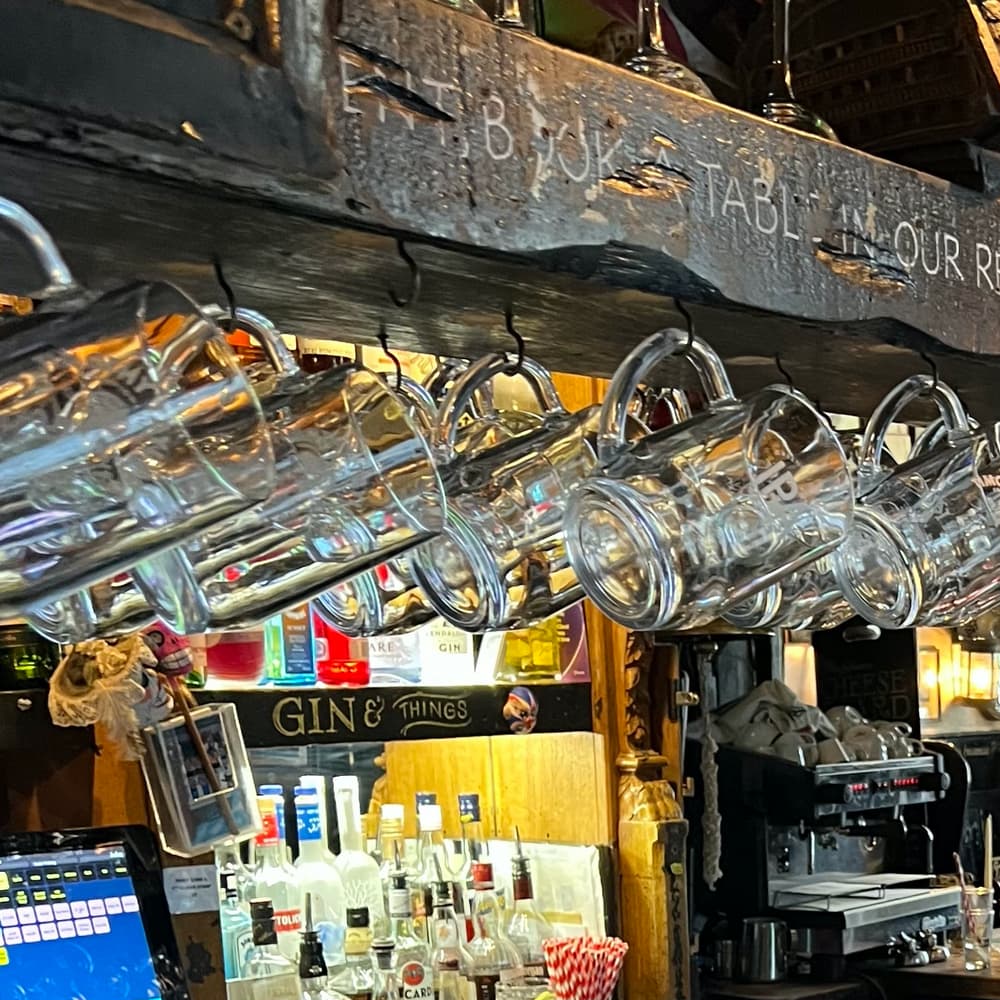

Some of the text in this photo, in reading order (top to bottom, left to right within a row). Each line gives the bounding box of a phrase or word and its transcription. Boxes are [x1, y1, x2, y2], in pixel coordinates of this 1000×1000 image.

[895, 221, 964, 281] OUR
[439, 643, 461, 654] GIN
[271, 693, 470, 738] GIN & THINGS
[404, 986, 432, 1000] CARD
